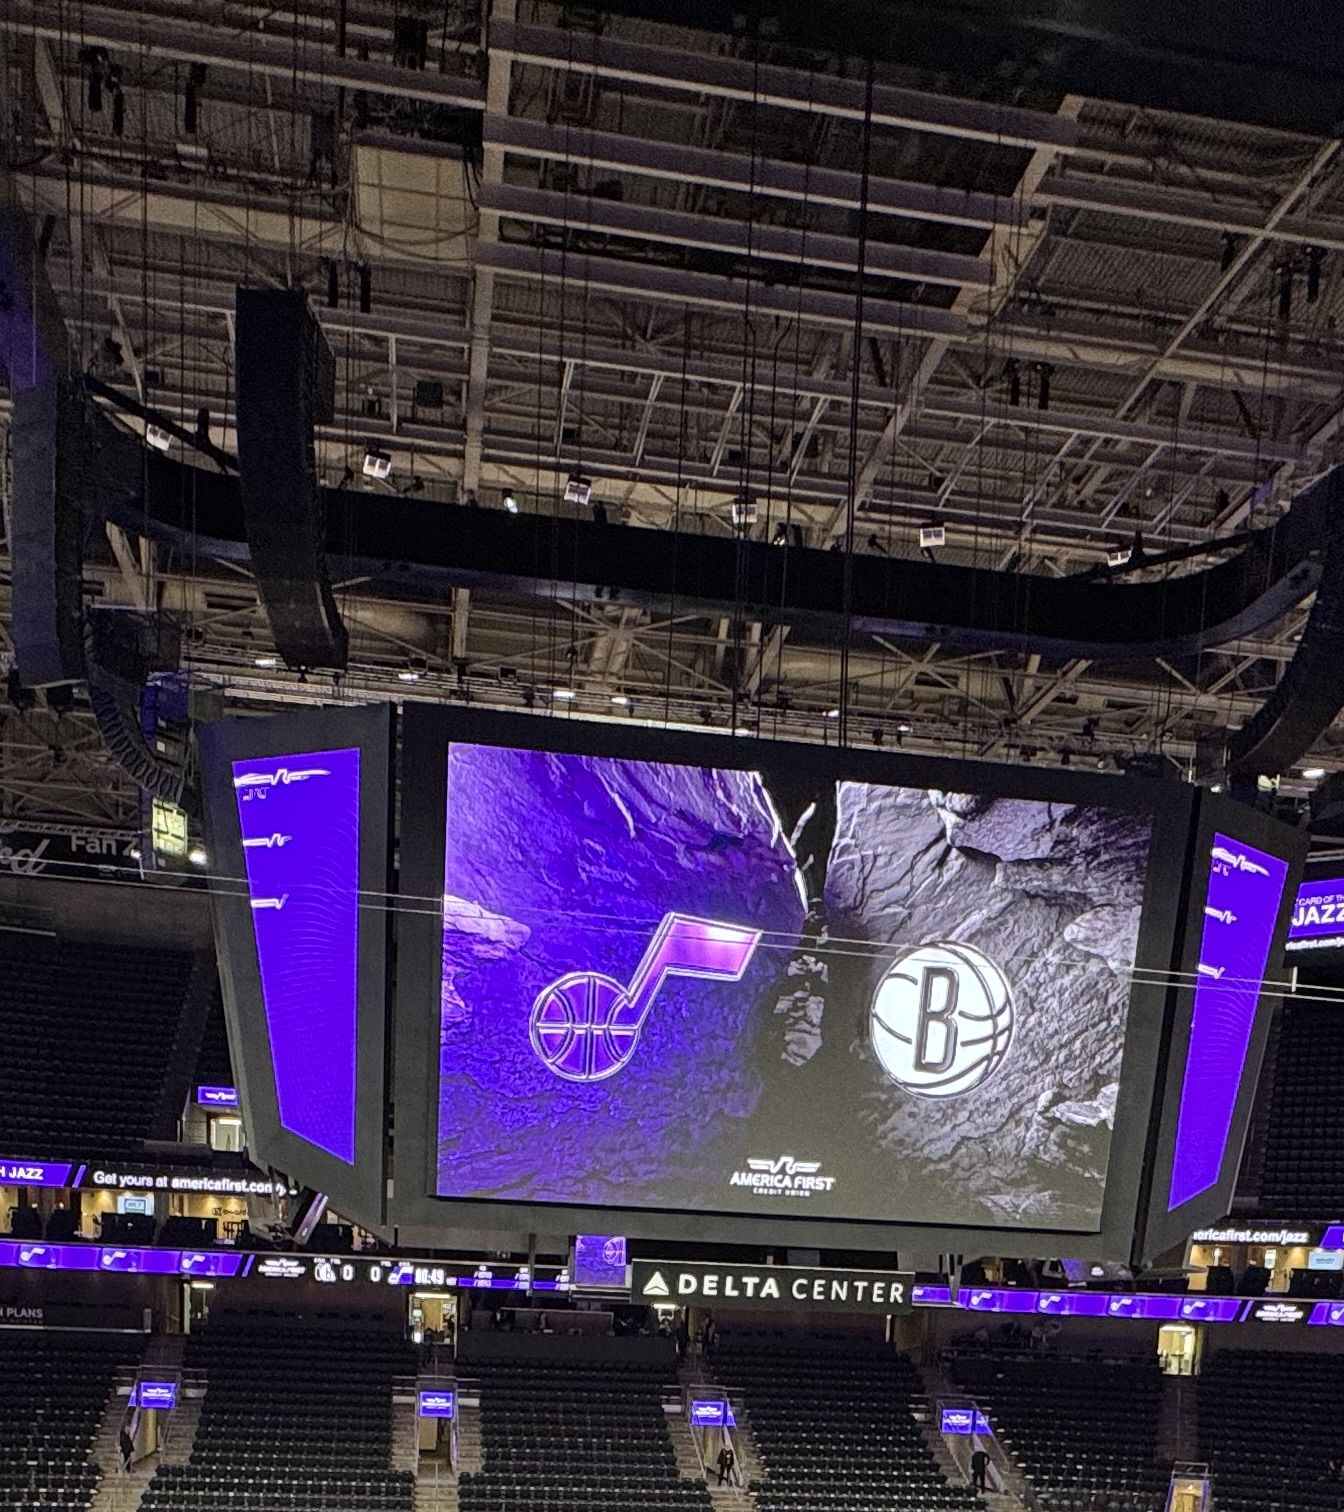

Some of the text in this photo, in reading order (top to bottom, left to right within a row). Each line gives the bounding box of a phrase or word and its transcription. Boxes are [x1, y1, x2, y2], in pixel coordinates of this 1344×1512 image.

[921, 961, 958, 1076] B
[8, 1166, 44, 1181] JAZZ
[93, 1171, 117, 1185] Get
[118, 1175, 154, 1188] yours
[155, 1178, 169, 1188] at
[729, 1171, 835, 1191] AMERICA FIRST
[343, 1265, 353, 1281] 0
[371, 1267, 381, 1282] 0
[678, 1274, 904, 1303] DELTA CENTER
[6, 1308, 43, 1318] PLANS
